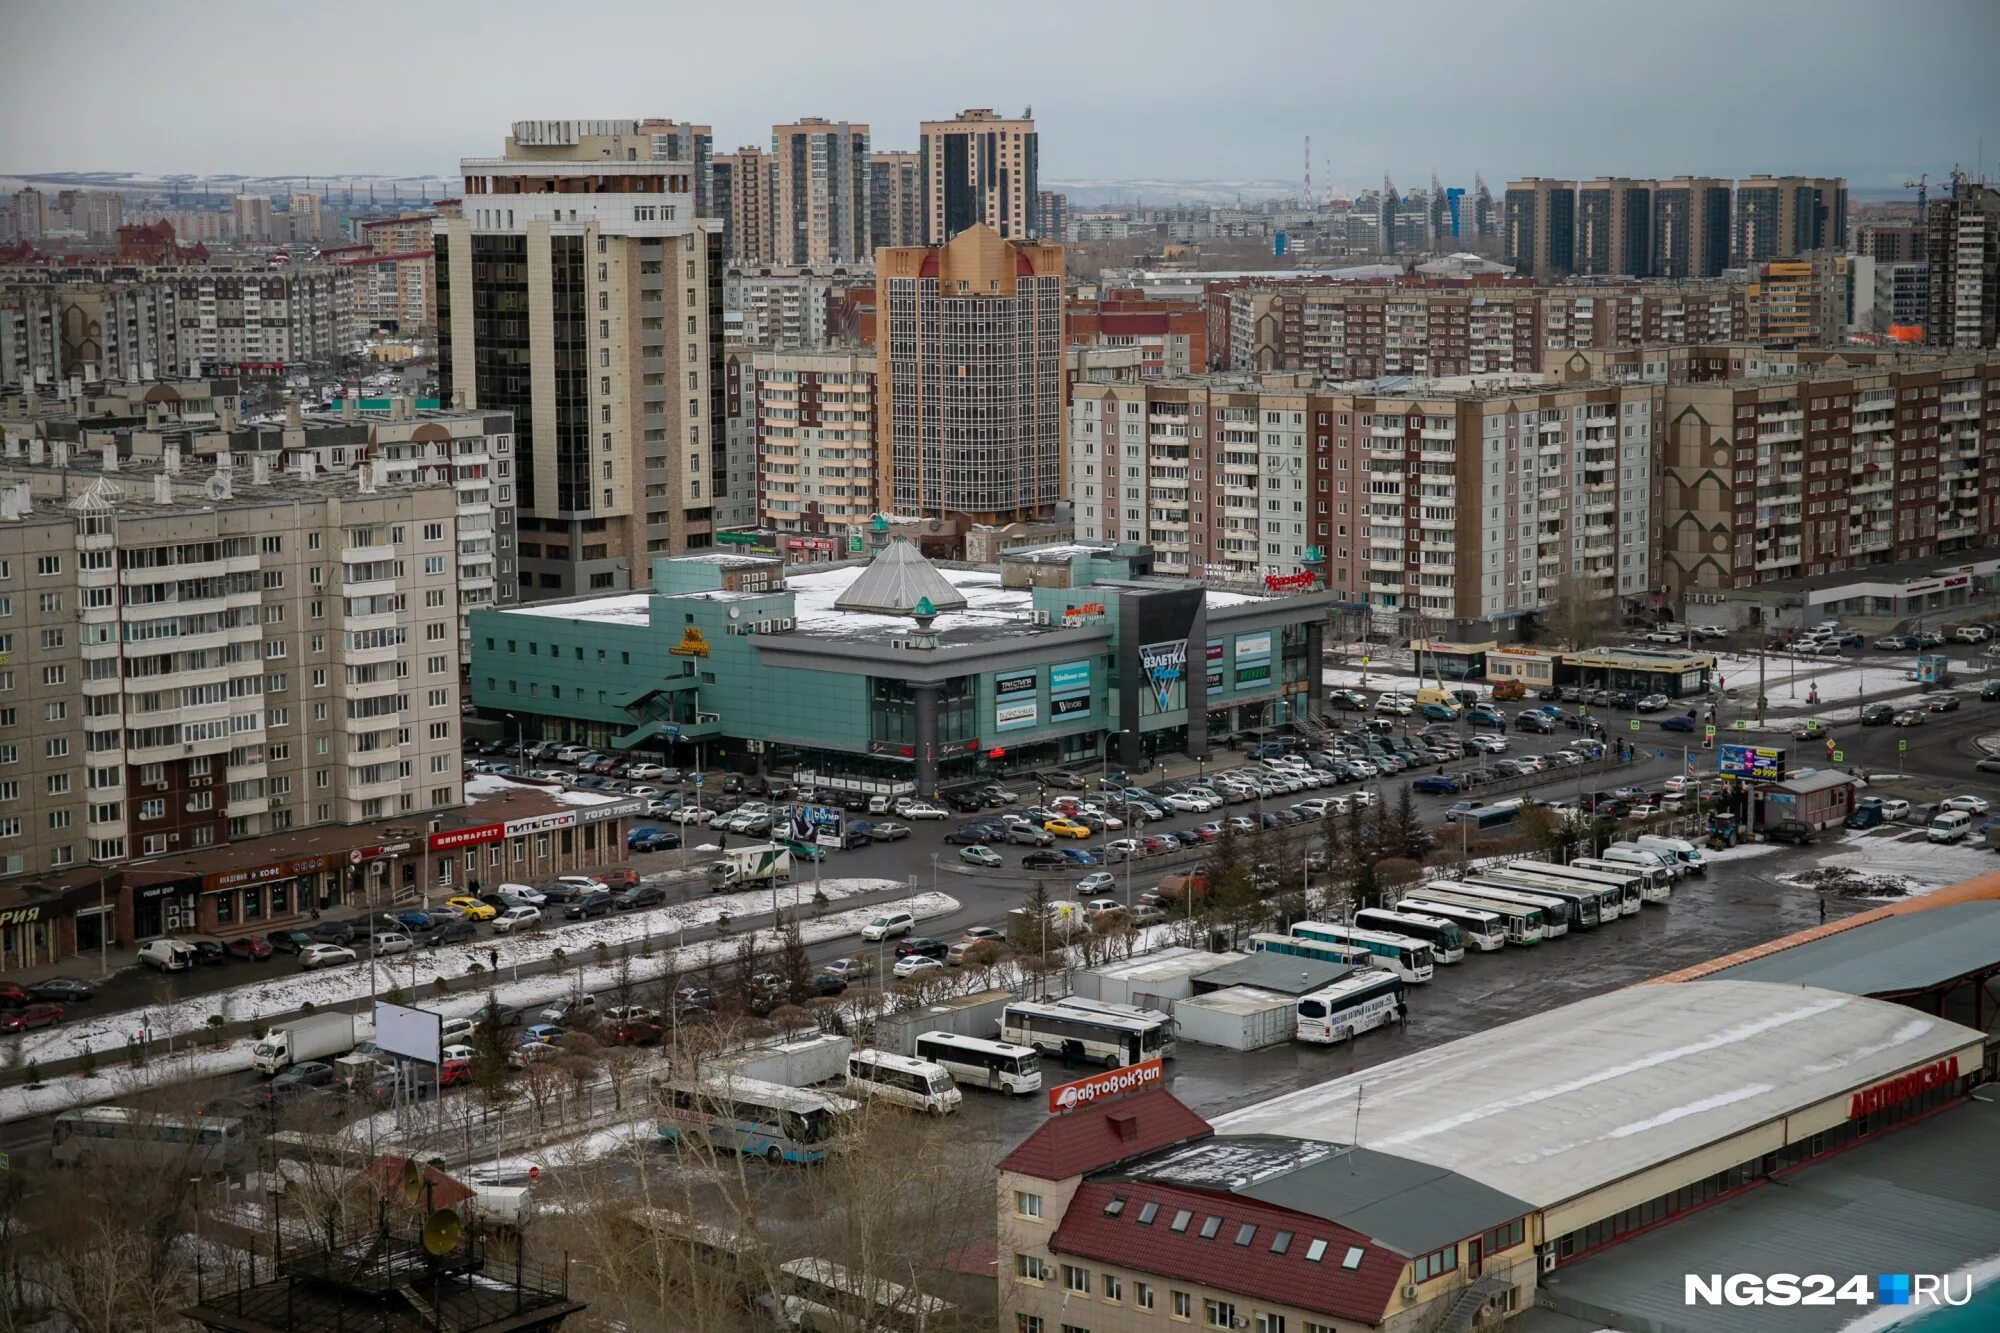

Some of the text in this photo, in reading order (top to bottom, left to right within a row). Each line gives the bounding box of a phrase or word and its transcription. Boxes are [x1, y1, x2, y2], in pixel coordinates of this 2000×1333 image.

[1144, 651, 1187, 669] ВЗЛЕТКА
[585, 802, 641, 820] TOYO TIRES
[506, 814, 575, 834] ПИТ СТОП
[437, 828, 498, 846] ШИНОМАРКЕТ
[219, 867, 280, 884] АКАДЕМИЯ КОФЕ
[1849, 1055, 1959, 1120] АВТОВОКЗАЛ
